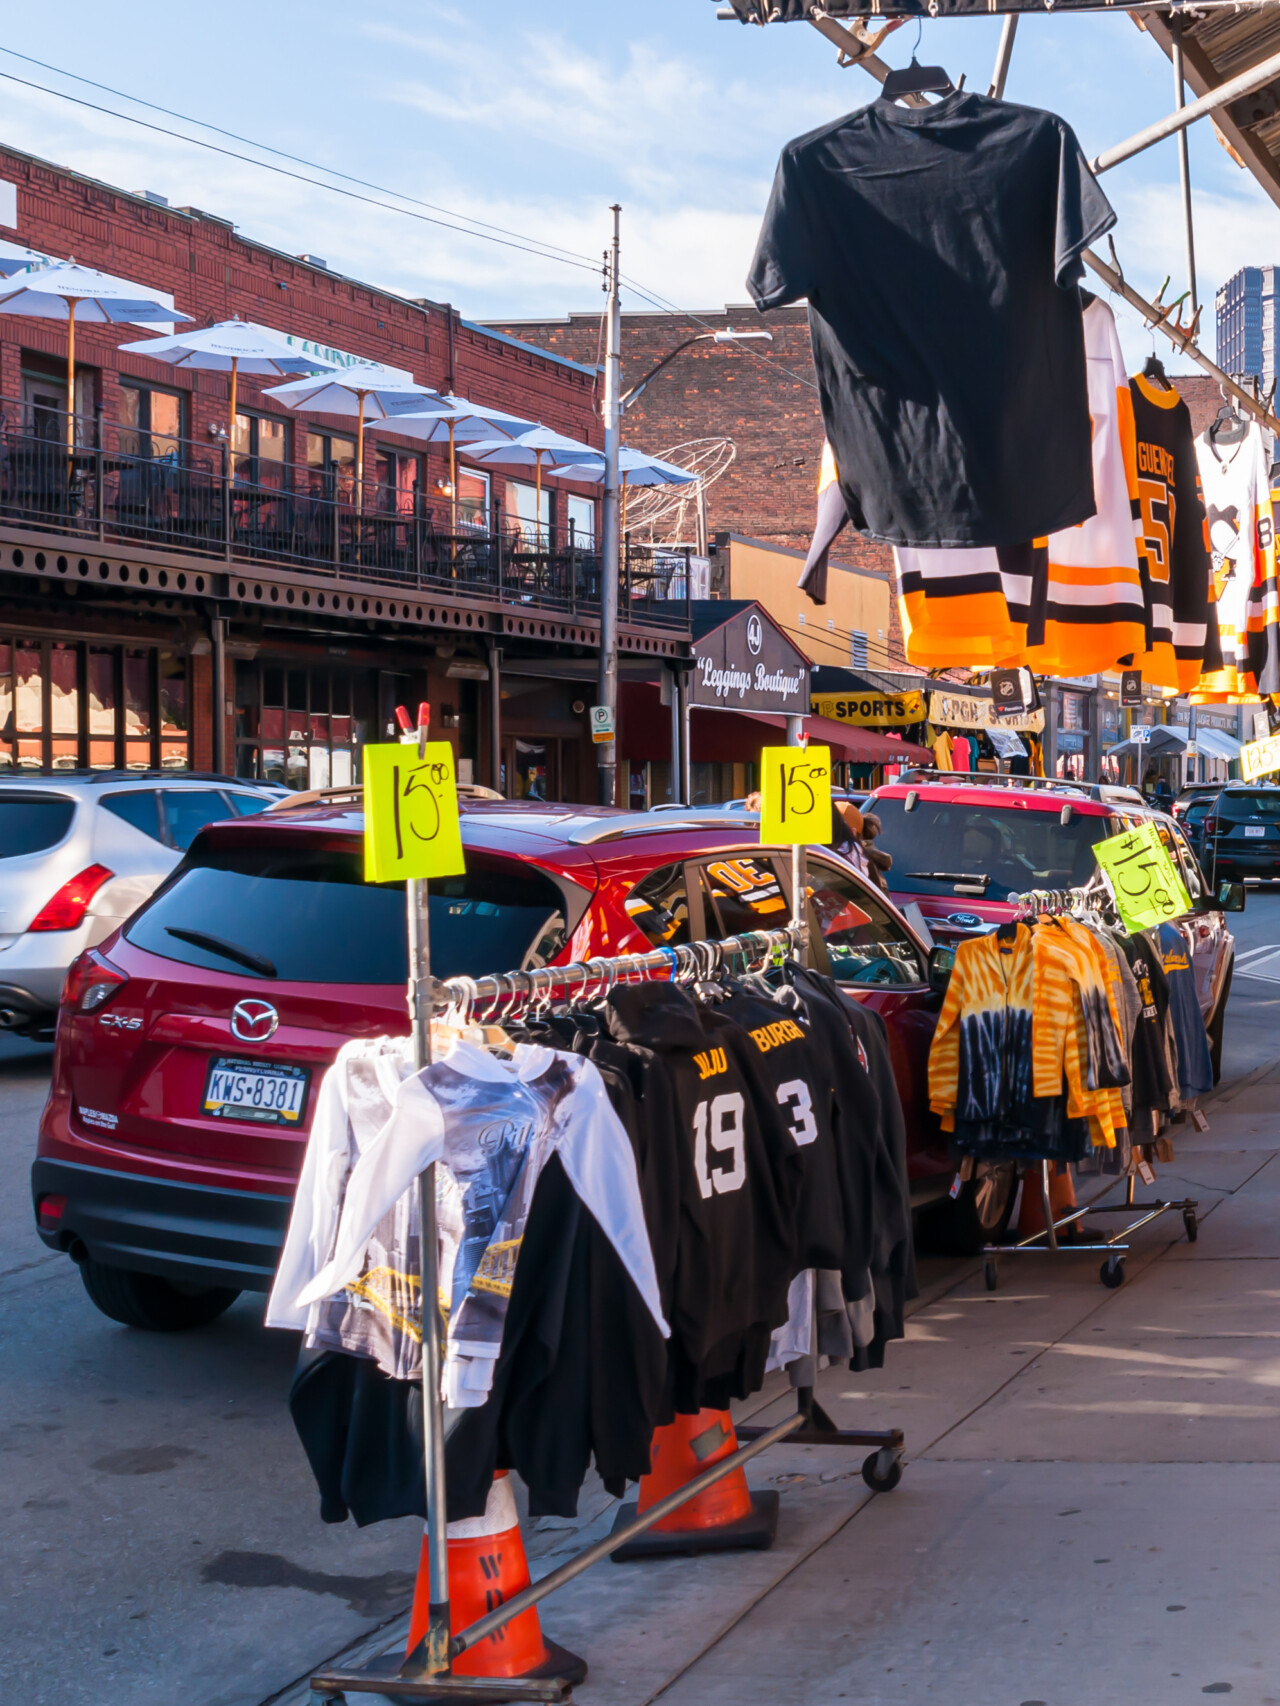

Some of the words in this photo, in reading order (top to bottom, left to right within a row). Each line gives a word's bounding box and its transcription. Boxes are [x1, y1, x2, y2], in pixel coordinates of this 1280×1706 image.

[836, 699, 906, 718] SPORTS
[100, 1013, 144, 1030] CX-5
[776, 1079, 818, 1147] 3
[693, 1092, 746, 1200] 19
